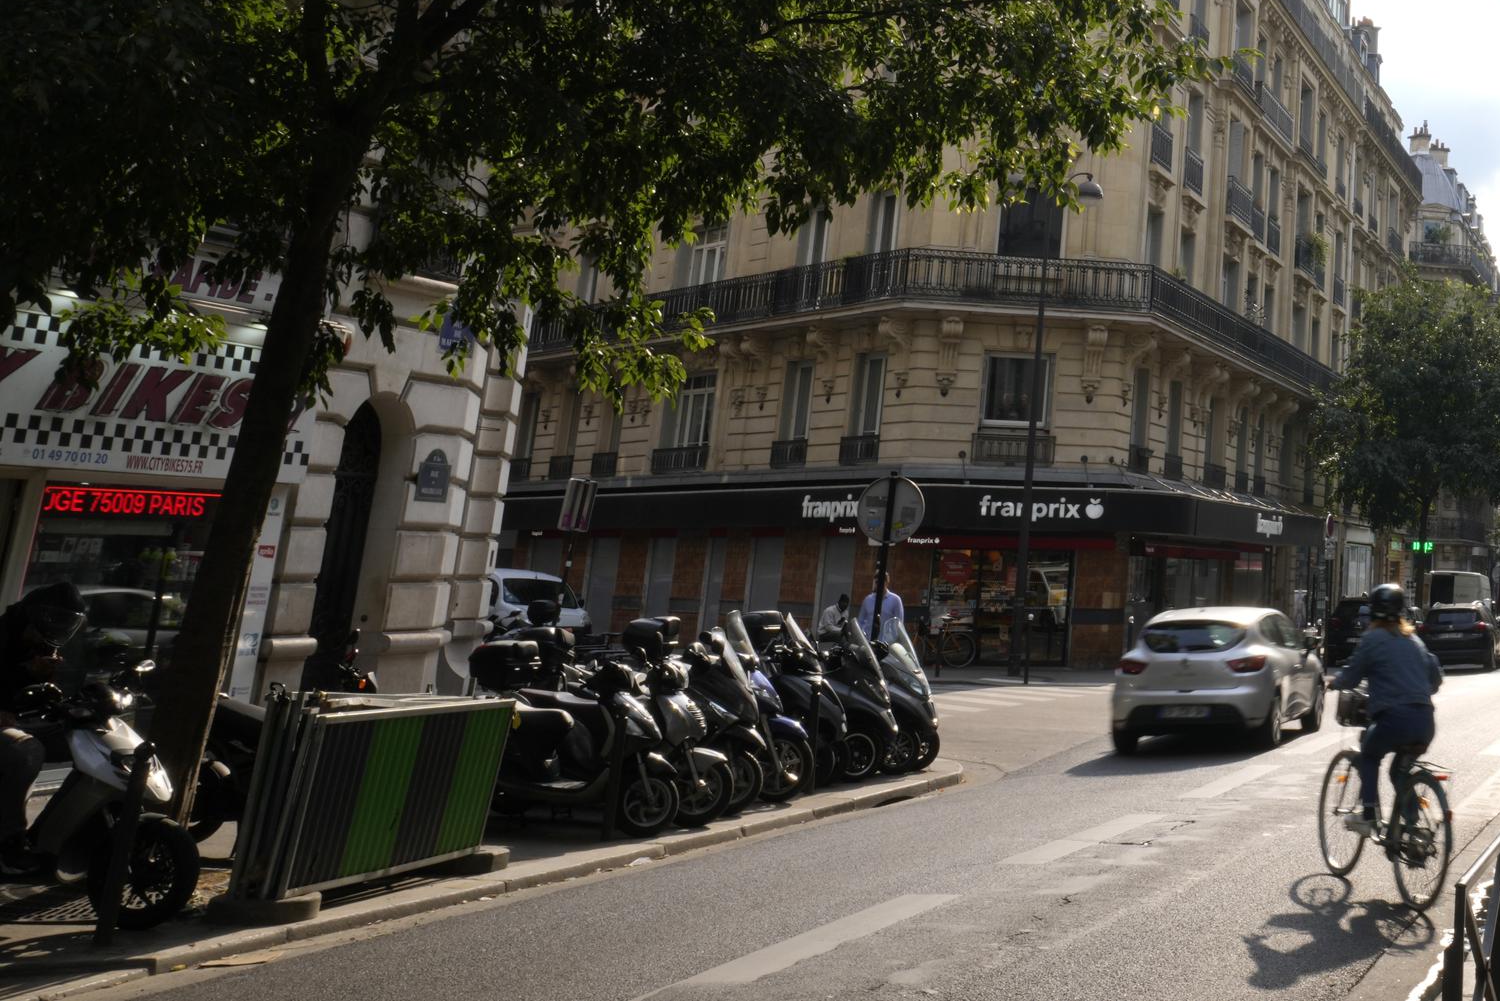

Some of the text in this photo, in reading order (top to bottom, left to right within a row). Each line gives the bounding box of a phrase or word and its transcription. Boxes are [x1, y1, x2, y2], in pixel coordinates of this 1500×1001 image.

[34, 358, 256, 430] BIKES
[32, 448, 108, 465] 01 49 70 01 20
[126, 455, 204, 474] WWW.CITYBIKES75.FR
[89, 491, 145, 514] 75009
[149, 494, 205, 517] PARIS
[801, 493, 859, 523] franprix
